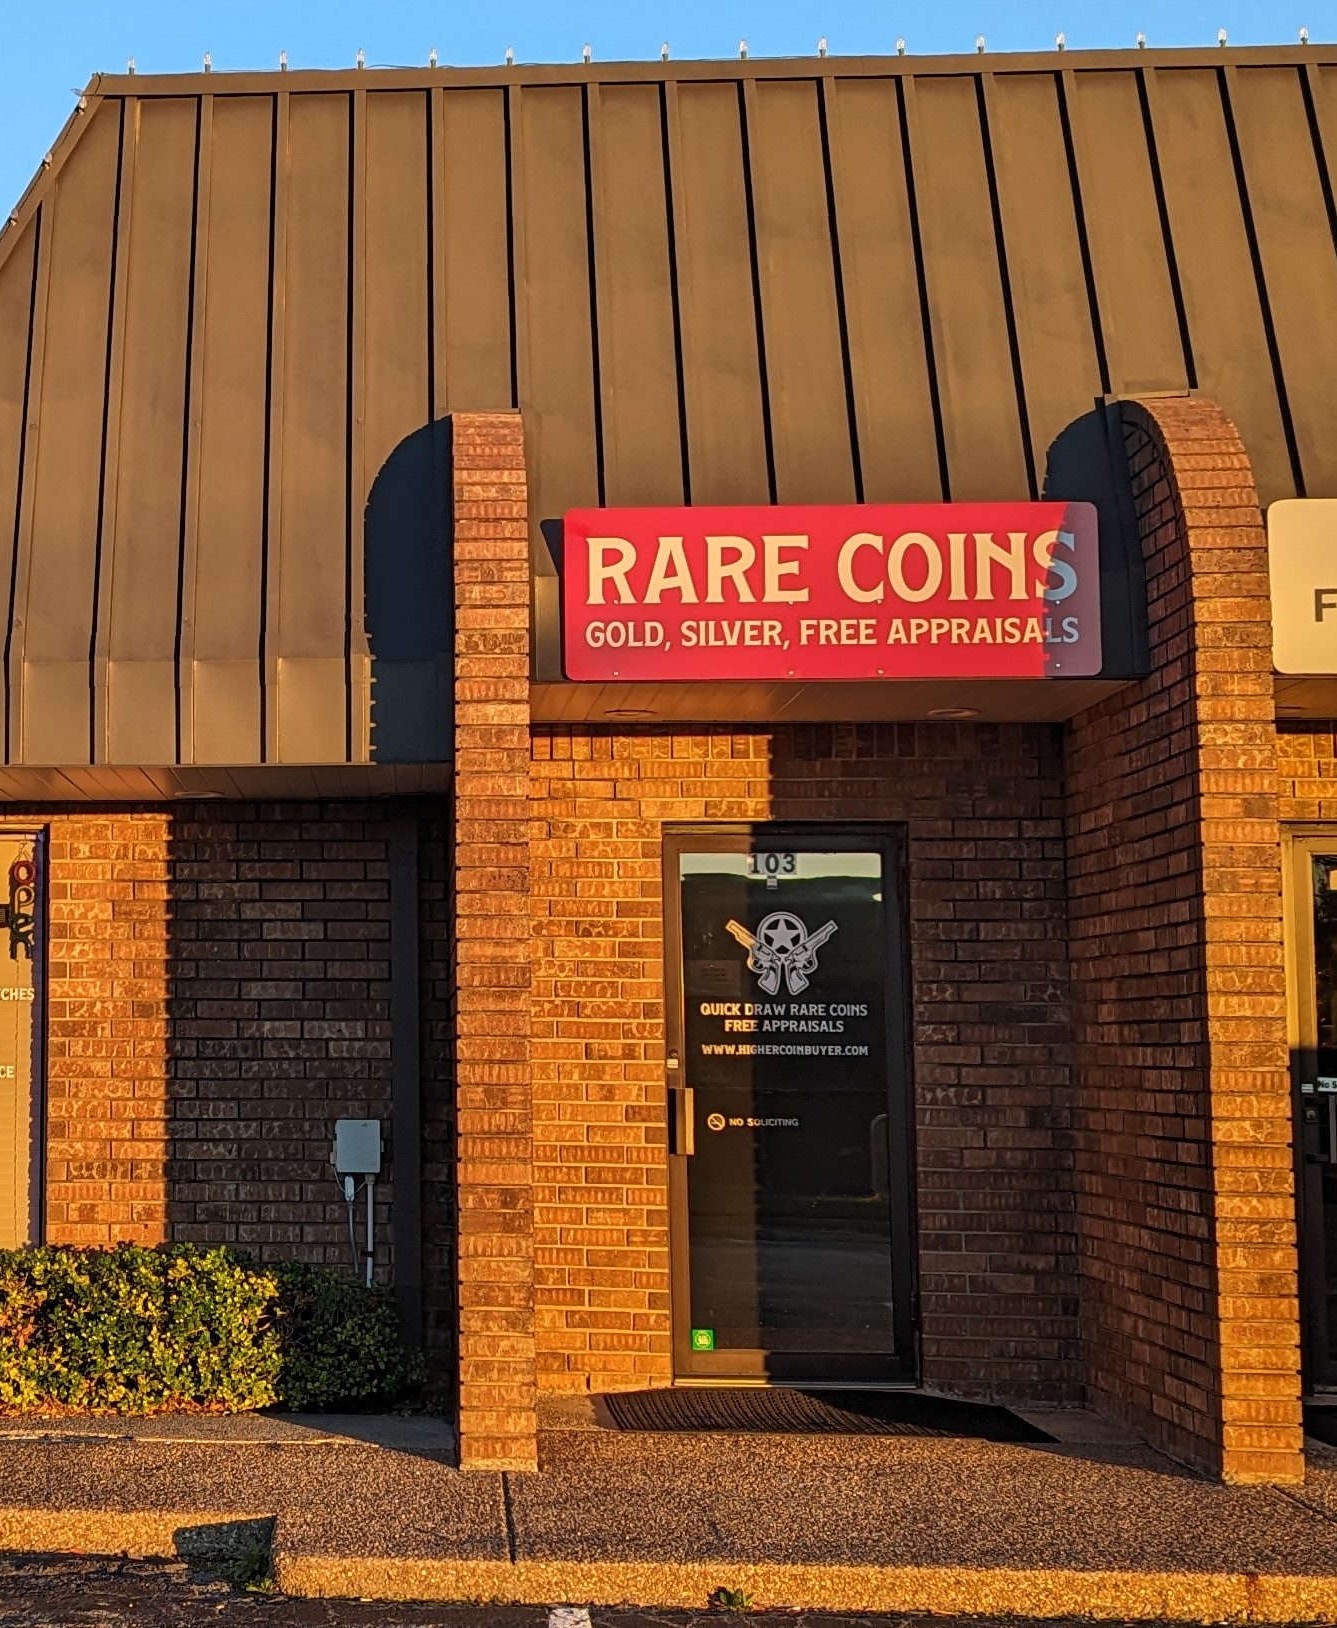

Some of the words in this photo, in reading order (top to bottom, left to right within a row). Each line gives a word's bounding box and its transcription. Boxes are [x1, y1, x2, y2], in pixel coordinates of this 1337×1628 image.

[585, 534, 810, 605] RARE
[837, 529, 1079, 603] COINS
[585, 621, 672, 651] GOLD,
[680, 620, 790, 650] SILVER,
[799, 618, 878, 645] FREE
[886, 616, 1080, 645] APPRAISALS
[751, 853, 796, 874] 103
[700, 1003, 742, 1016] QUICK
[744, 1003, 786, 1016] DRAW
[789, 1003, 827, 1016] RARE
[829, 1004, 868, 1016] COINS
[724, 1019, 759, 1032] FREE
[762, 1020, 844, 1032] APPRAISALS
[702, 1044, 869, 1056] WWW.HIGHERCOINBUYER.COM
[729, 1117, 744, 1126] NO
[747, 1117, 799, 1127] SOLICITING
